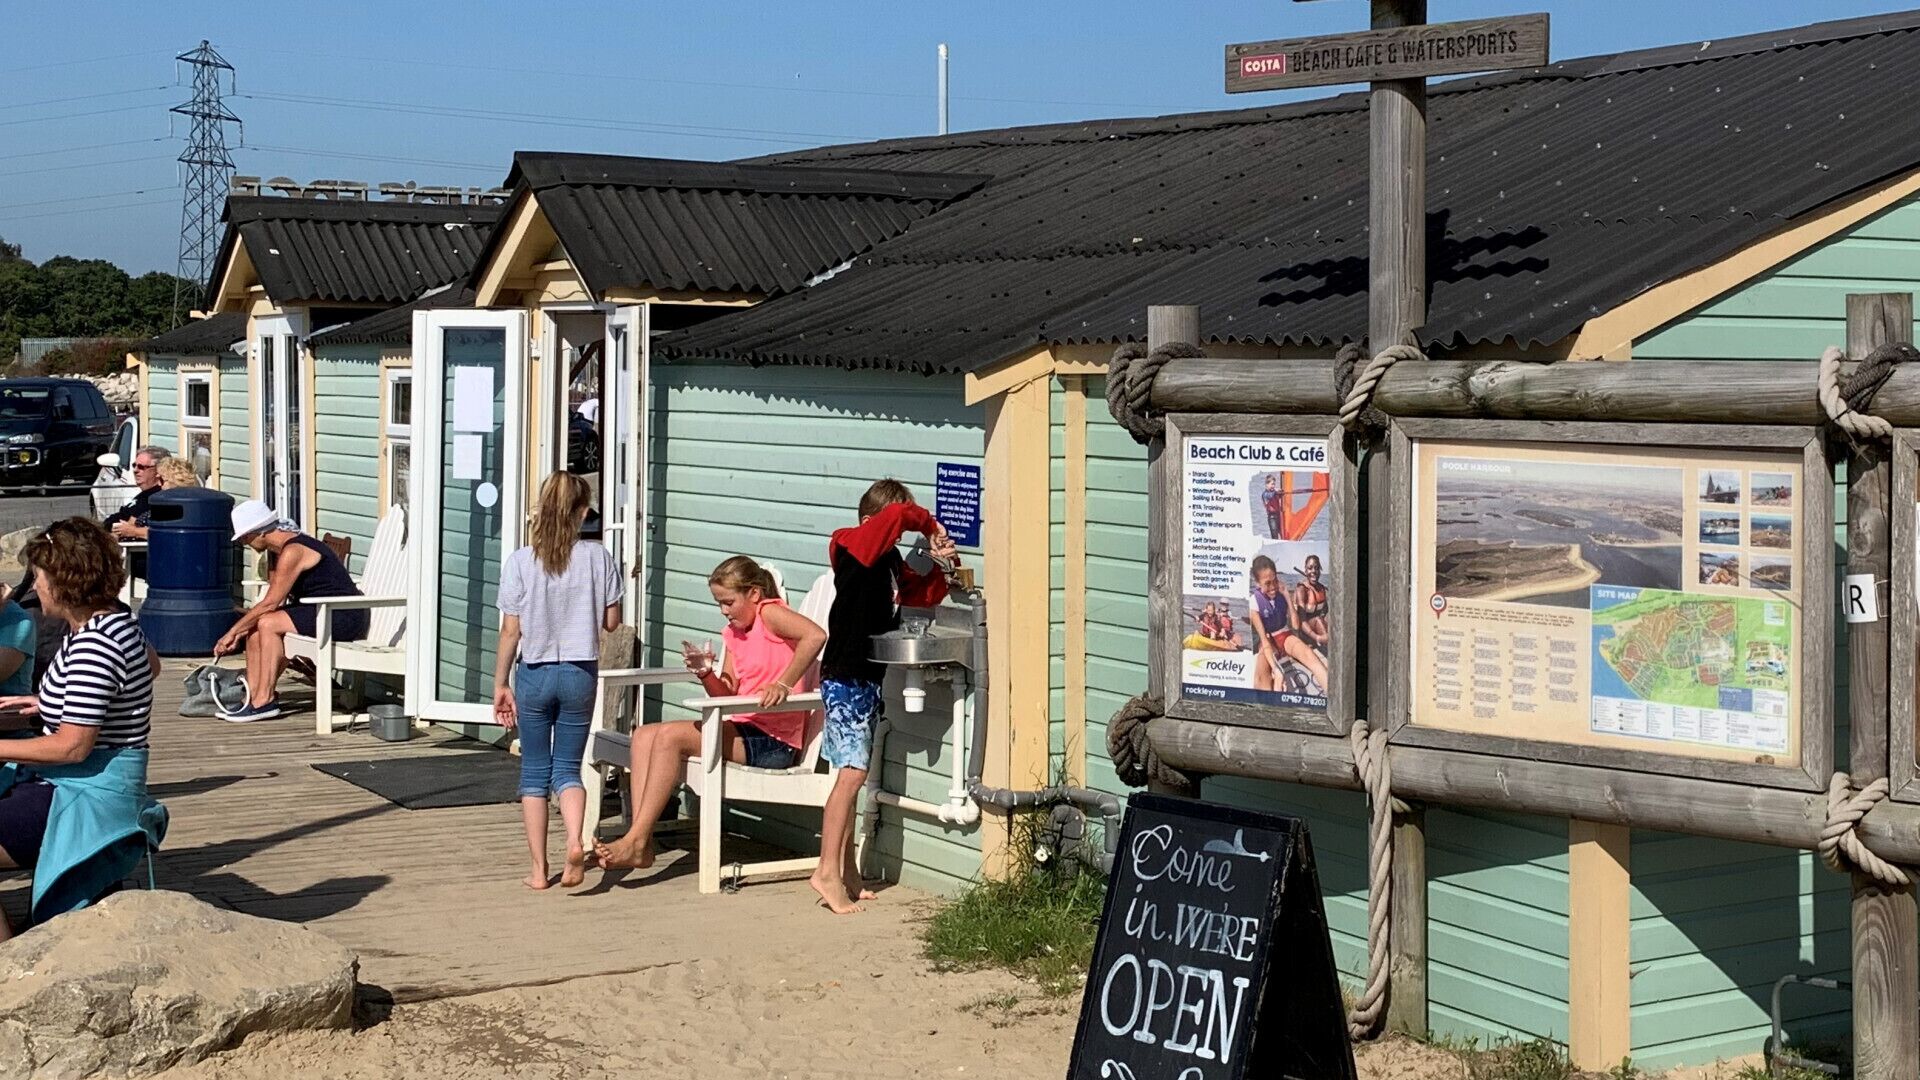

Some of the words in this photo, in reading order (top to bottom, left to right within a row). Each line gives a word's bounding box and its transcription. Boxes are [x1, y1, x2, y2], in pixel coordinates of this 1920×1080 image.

[1244, 60, 1281, 73] COSTA
[1292, 50, 1341, 73] BEACH
[1345, 45, 1382, 68] CAFE
[1388, 43, 1397, 64] &
[1402, 31, 1518, 62] WATERSPORTS
[1191, 445, 1235, 459] Beach
[1239, 445, 1271, 460] Club
[1276, 448, 1285, 460] &
[1289, 447, 1325, 461] Café
[938, 467, 948, 478] Dog
[1192, 478, 1235, 486] Paddleboarding
[1223, 555, 1246, 563] offering
[1597, 589, 1616, 599] SITE
[1617, 591, 1638, 600] MAP
[1850, 585, 1866, 614] R
[1206, 660, 1246, 675] rockley
[1185, 687, 1226, 698] rockley.org
[1132, 824, 1236, 892] Come
[1101, 953, 1250, 1064] OPEN
